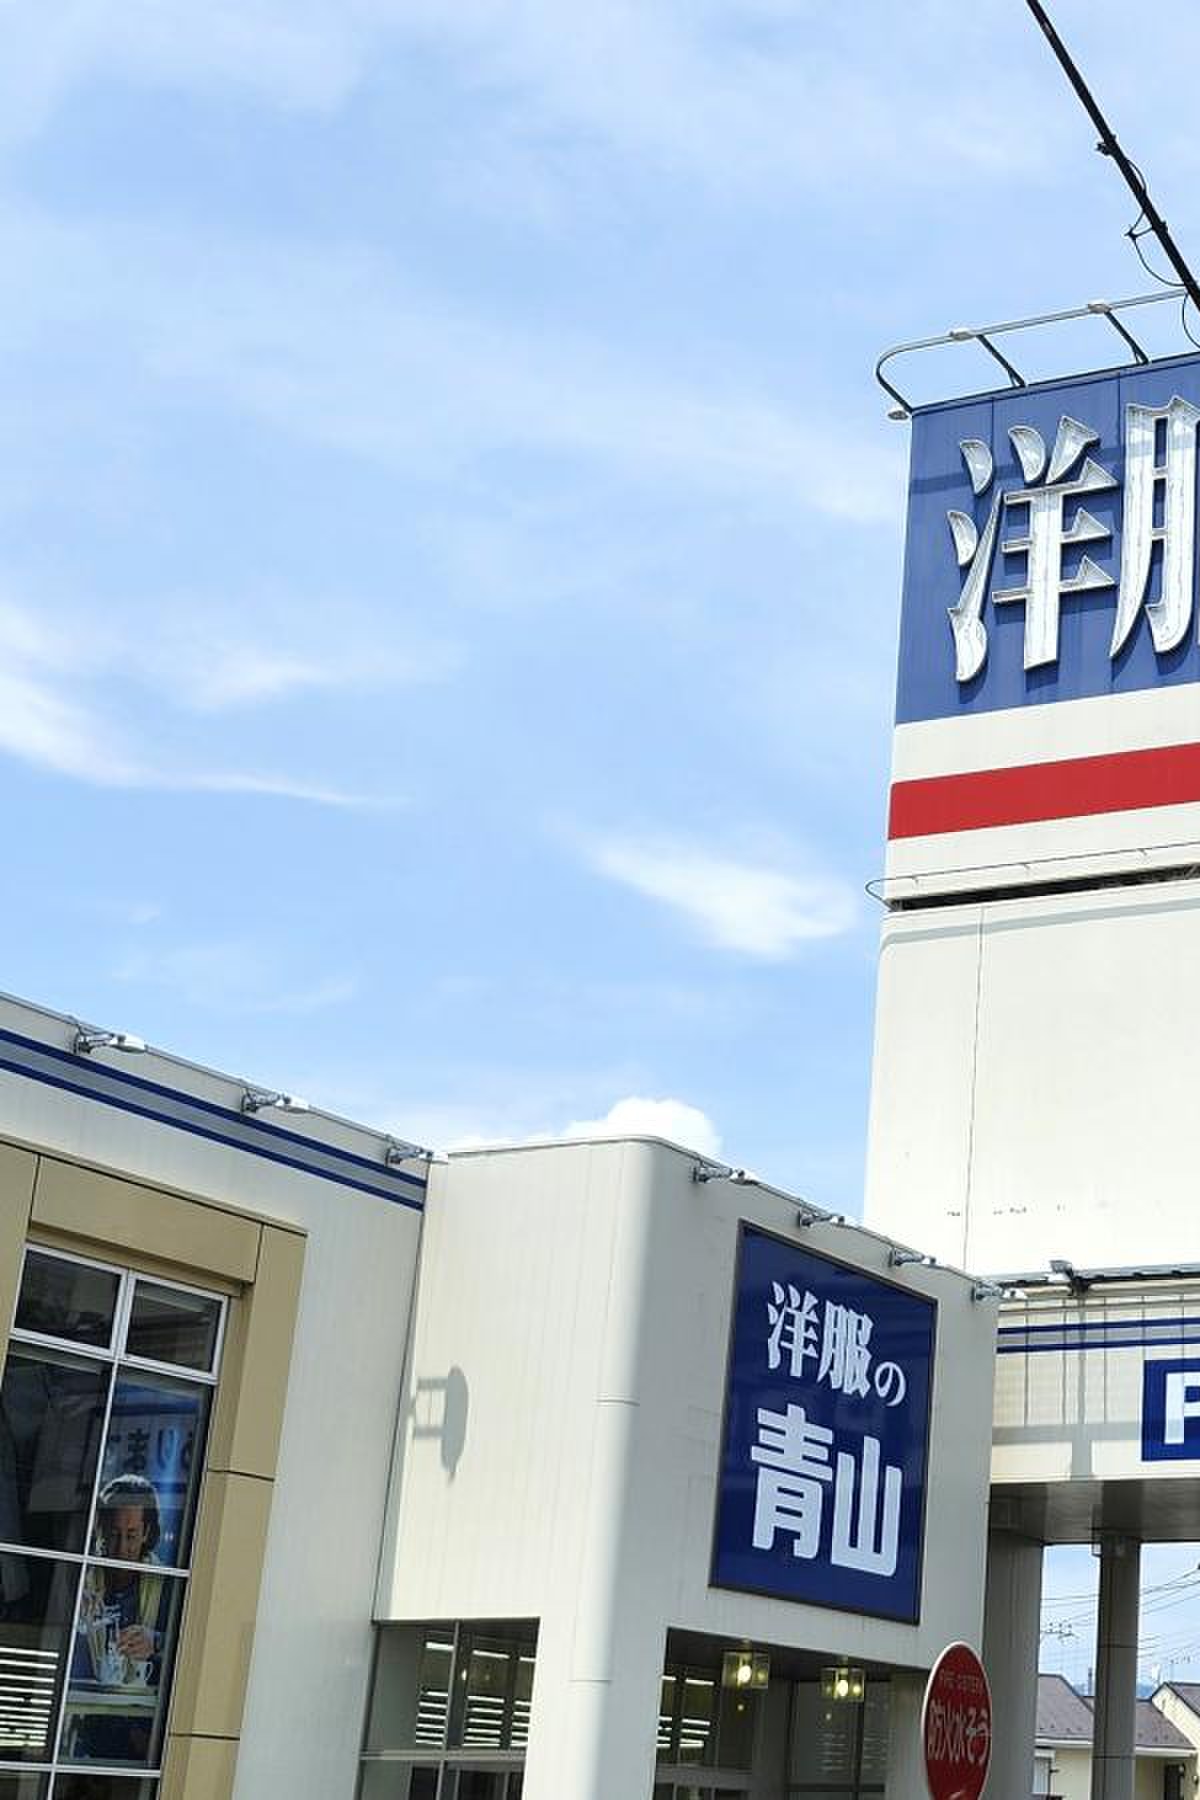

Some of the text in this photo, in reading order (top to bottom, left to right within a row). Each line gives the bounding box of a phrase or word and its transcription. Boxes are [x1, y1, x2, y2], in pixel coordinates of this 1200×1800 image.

[767, 1281, 907, 1407] 洋服の
[751, 1403, 903, 1577] 青山
